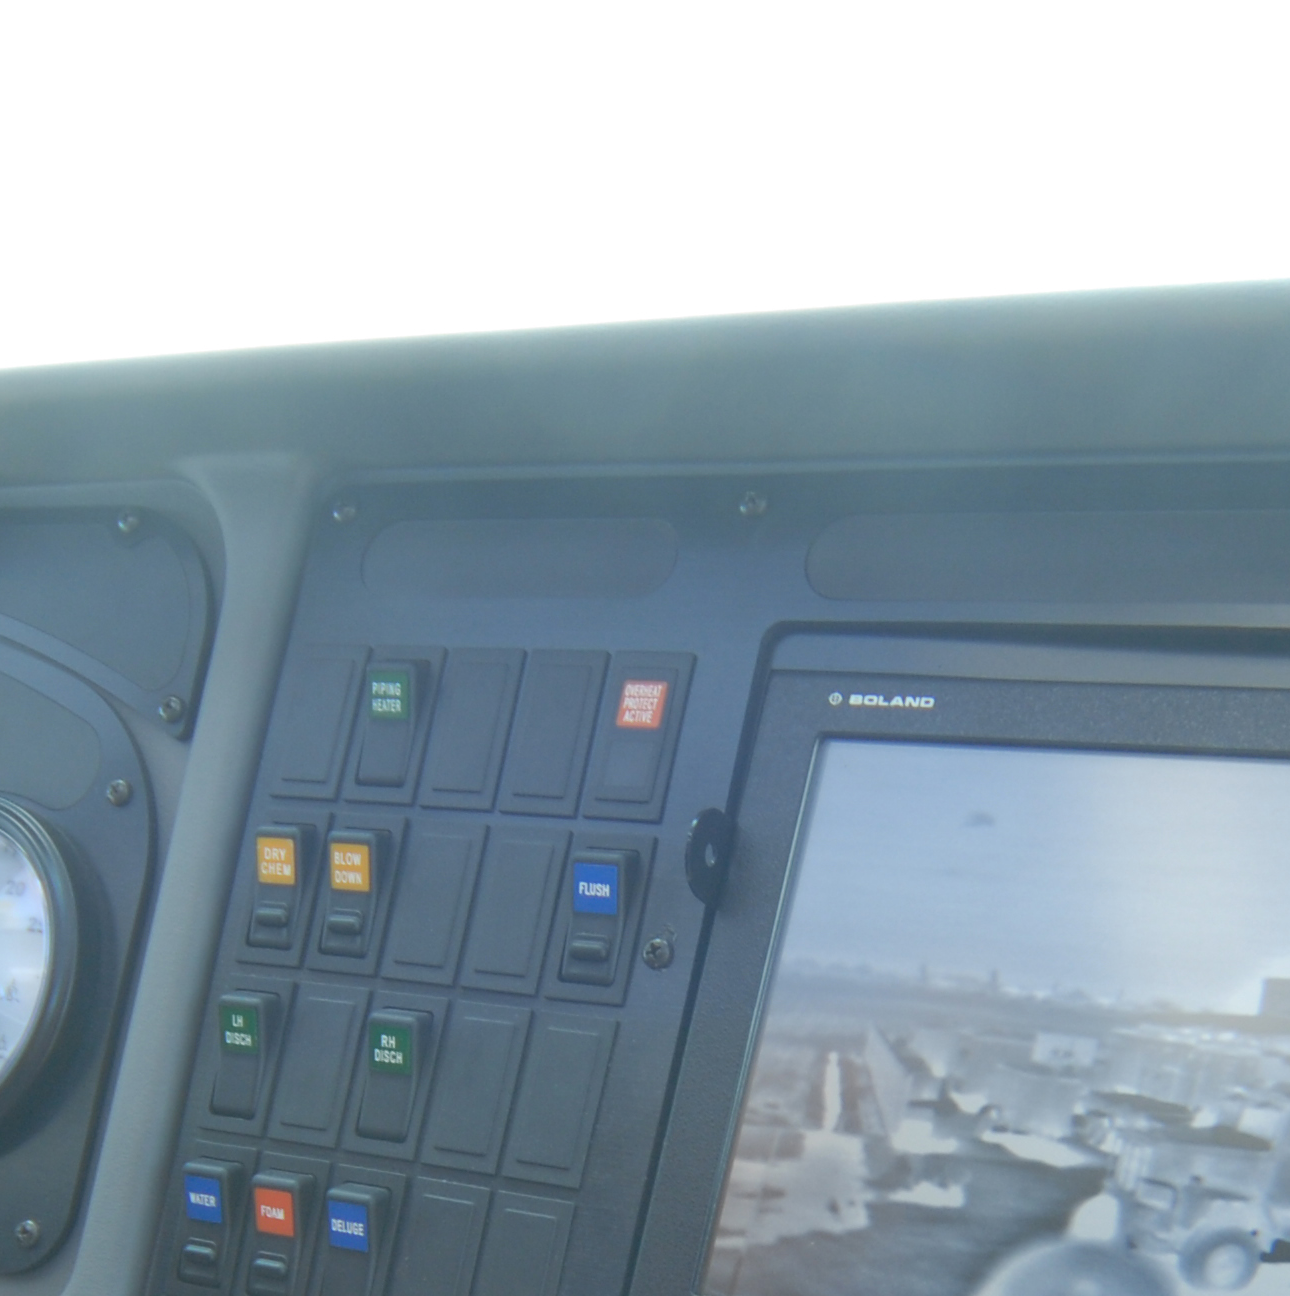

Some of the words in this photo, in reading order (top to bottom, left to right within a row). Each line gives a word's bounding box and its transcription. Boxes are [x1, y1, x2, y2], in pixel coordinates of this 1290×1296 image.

[372, 681, 402, 697] PIPING
[624, 683, 663, 696] OVERHEAT
[371, 697, 402, 713] HEATER
[623, 696, 659, 710] PROTECT
[848, 693, 936, 708] BOLAND
[622, 709, 654, 723] ACTIVE
[264, 847, 286, 861] DRY
[334, 851, 361, 866] BLOW
[260, 861, 291, 877] CHEM
[334, 870, 362, 886] DOWN
[578, 881, 610, 898] FLUSH
[232, 1013, 244, 1028] LH
[225, 1030, 252, 1047] DISCH
[380, 1033, 396, 1048] RH
[374, 1048, 403, 1064] DISCH
[188, 1191, 217, 1208] WATER
[260, 1204, 285, 1220] FOAM
[331, 1218, 365, 1237] DELUGE
